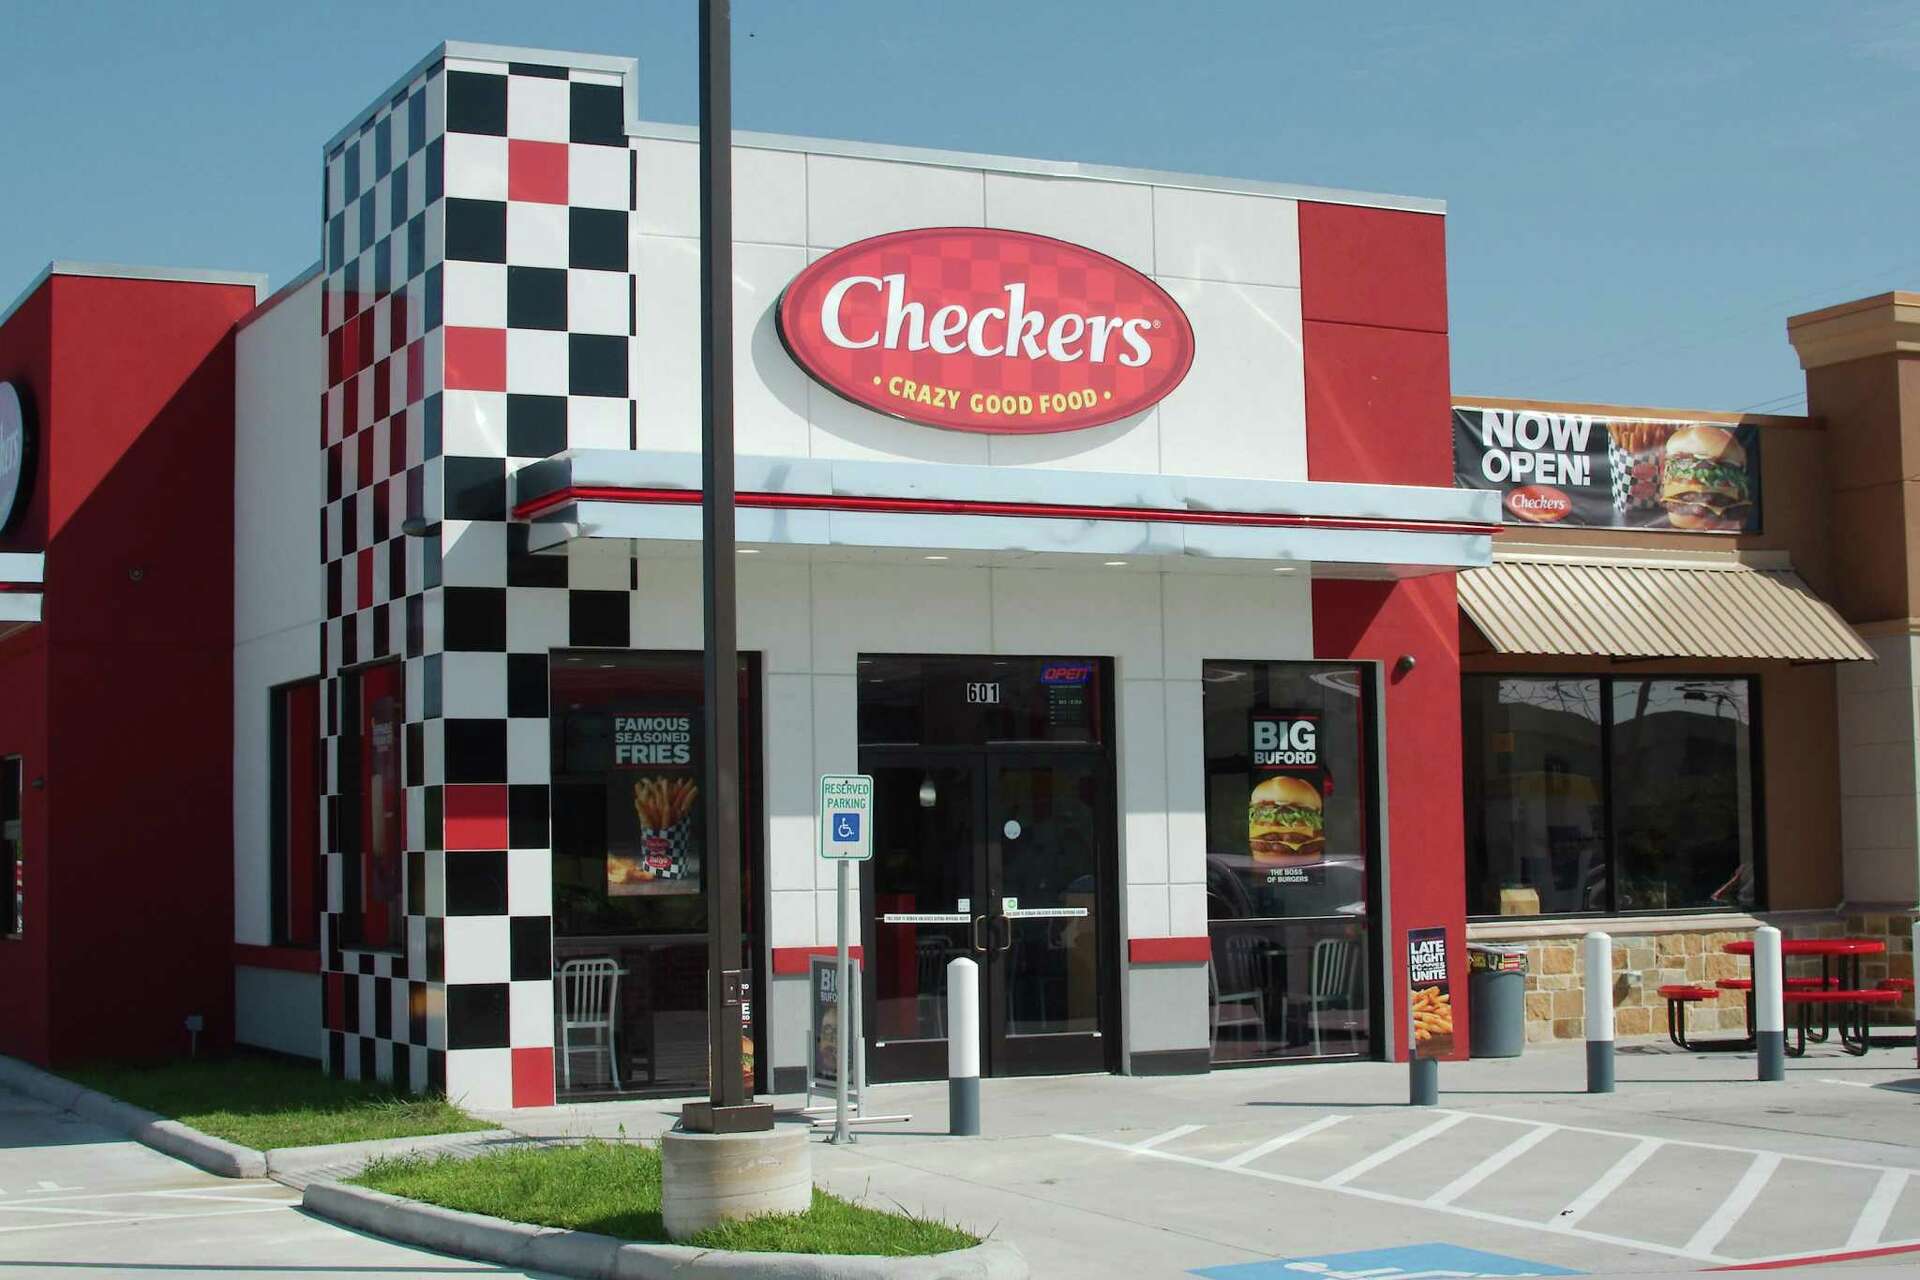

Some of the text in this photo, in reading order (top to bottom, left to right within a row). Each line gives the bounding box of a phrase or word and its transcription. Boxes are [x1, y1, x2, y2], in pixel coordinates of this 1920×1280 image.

[820, 273, 1153, 368] Checkers
[889, 376, 1098, 415] CRAZY GOOD FOOD
[1481, 411, 1593, 452] NOW
[1481, 449, 1591, 486] OPEN!
[1511, 494, 1565, 510] Checkers
[1043, 667, 1089, 681] OPEN
[967, 683, 999, 703] 601
[615, 718, 690, 732] FAMOUS
[615, 732, 690, 743] SEASONED
[1253, 720, 1316, 751] BIG
[615, 744, 690, 765] FRIES
[1254, 751, 1317, 765] BUFORD
[824, 783, 869, 795] RESERVED
[827, 798, 866, 809] PARKING
[1270, 868, 1283, 876] THE
[1266, 876, 1276, 884] OF
[1410, 940, 1445, 955] LATE
[1411, 953, 1445, 965] NIGHT
[1412, 969, 1447, 982] UNITE
